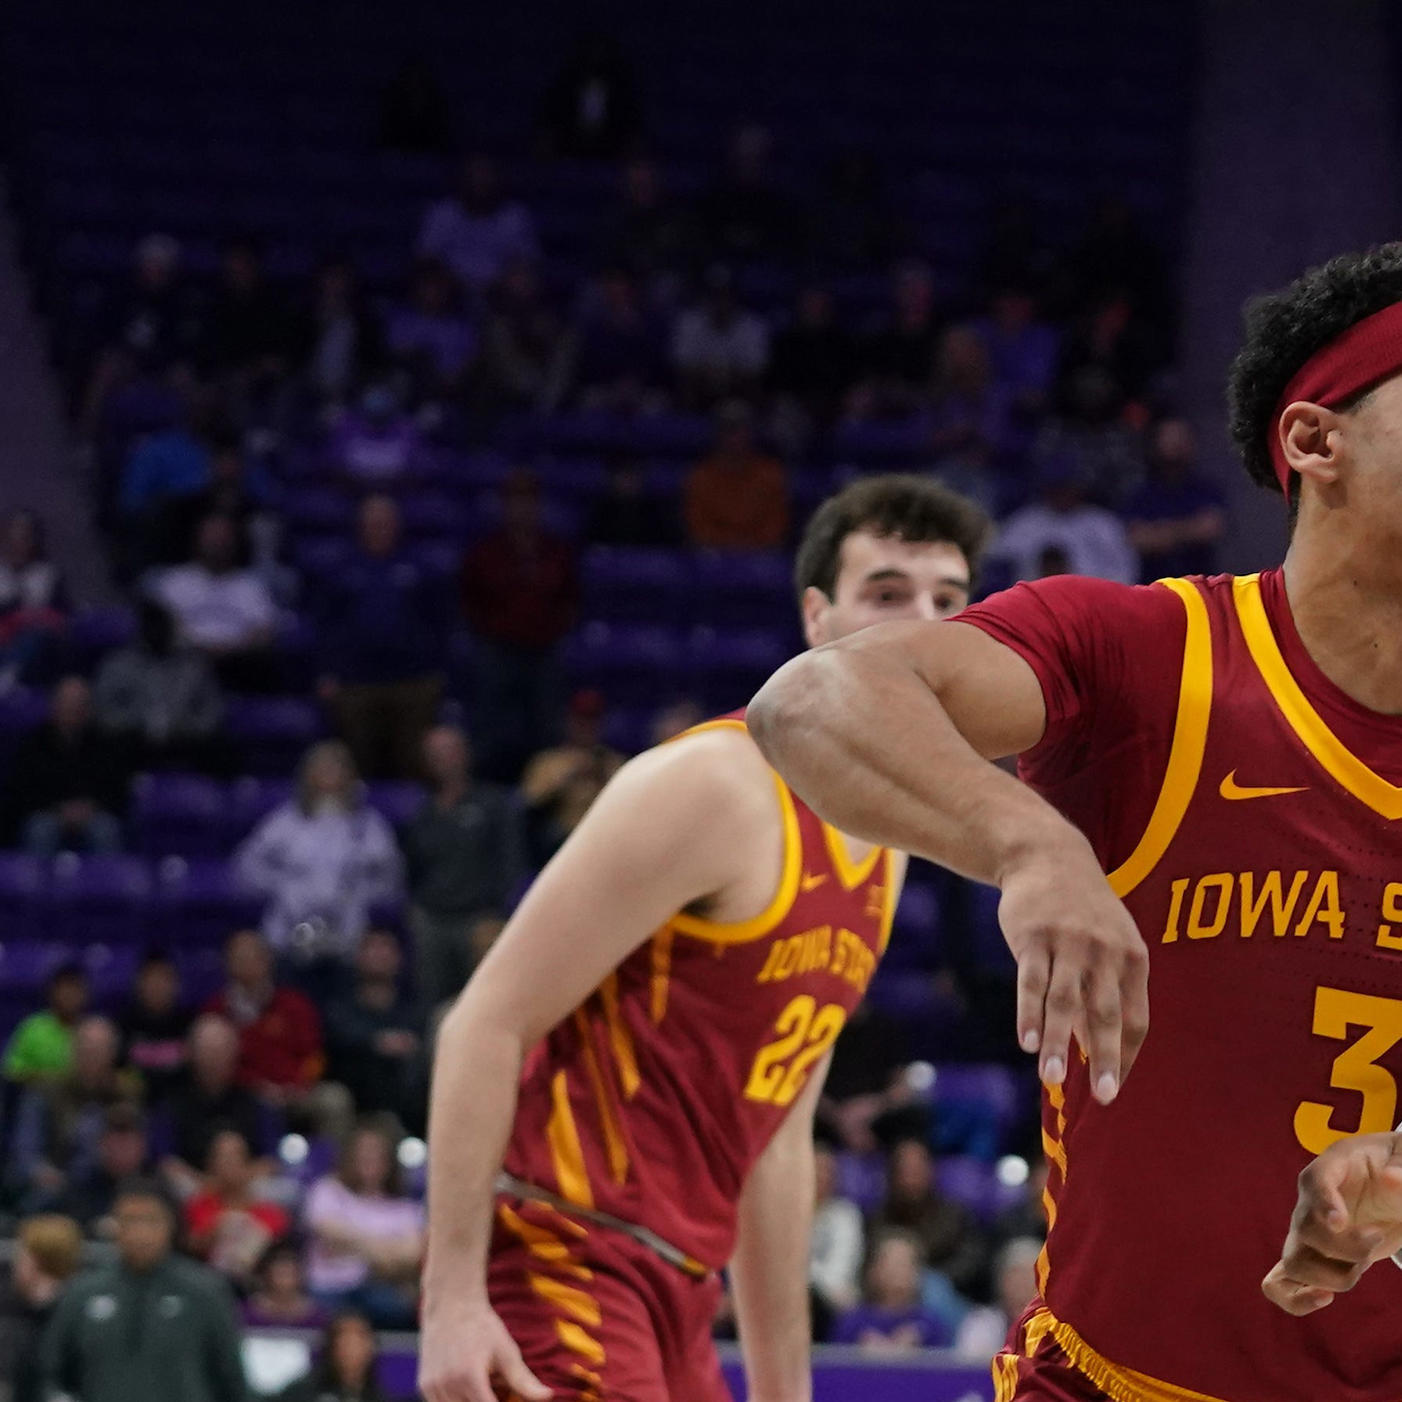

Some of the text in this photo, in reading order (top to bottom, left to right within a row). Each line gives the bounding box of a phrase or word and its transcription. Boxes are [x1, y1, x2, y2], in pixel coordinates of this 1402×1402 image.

[1162, 870, 1345, 944] IOWA
[756, 924, 832, 984] IOWA
[744, 994, 847, 1106] 22
